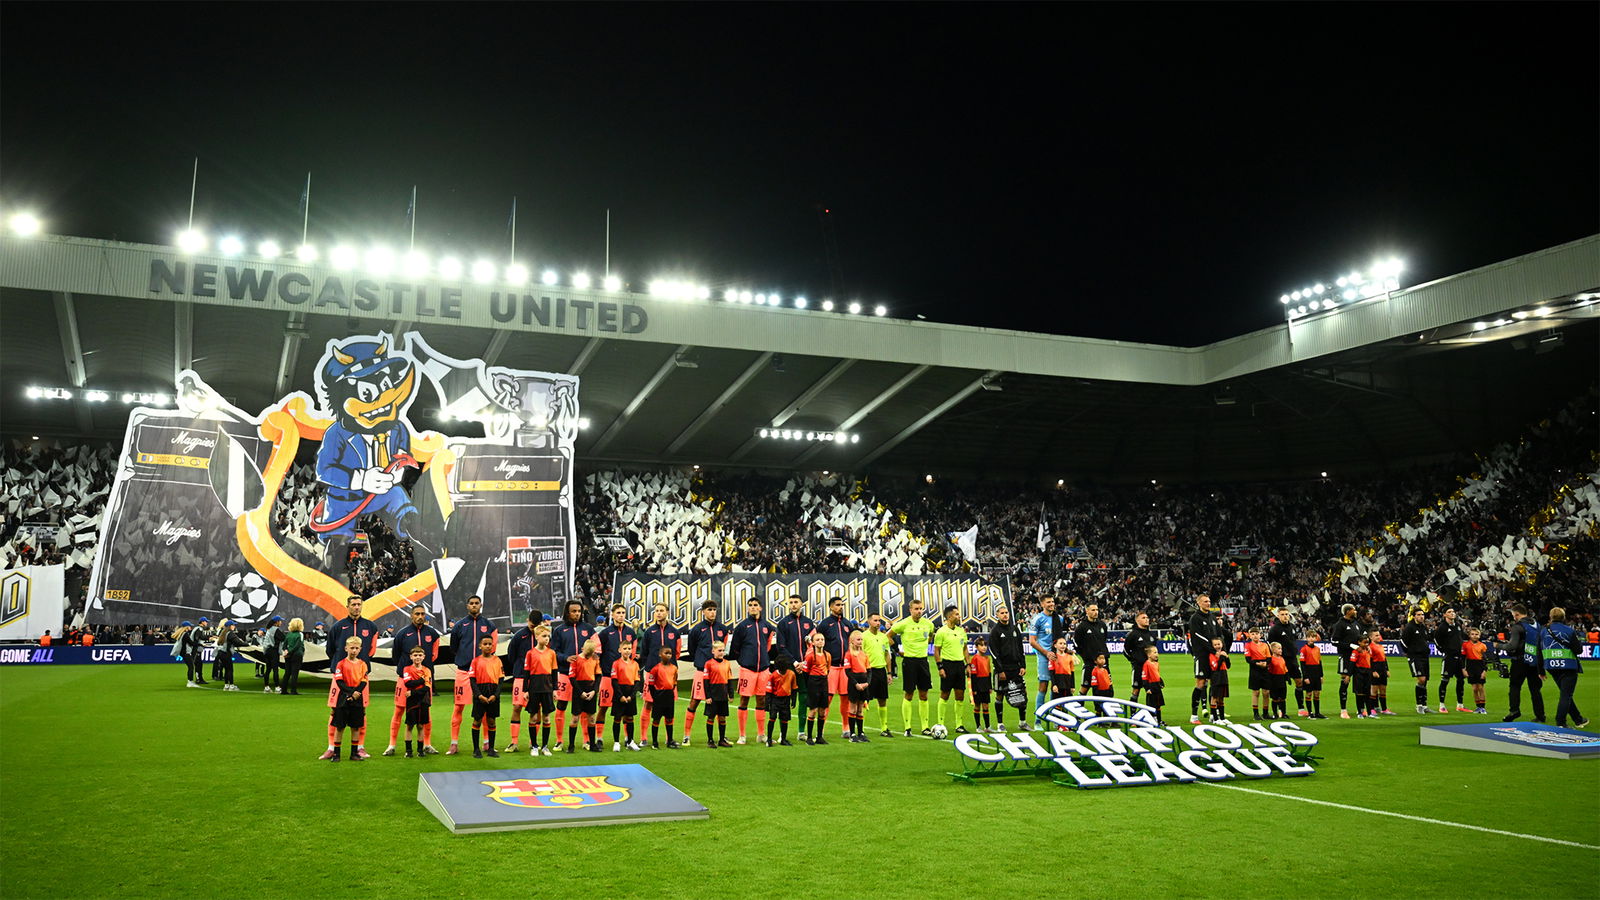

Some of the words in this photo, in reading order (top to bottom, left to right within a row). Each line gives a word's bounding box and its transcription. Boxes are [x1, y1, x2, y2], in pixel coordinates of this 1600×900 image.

[150, 259, 462, 319] NEWCASTLE
[490, 291, 649, 333] UNITED
[171, 431, 215, 454] Magpies
[494, 459, 530, 480] Magpies
[153, 520, 202, 546] Magpies
[107, 591, 129, 600] 1892
[622, 578, 712, 629] BACK
[721, 578, 755, 627] IN
[879, 578, 904, 622] &
[0, 649, 30, 662] COME
[31, 649, 54, 662] ALL
[92, 650, 131, 661] UEFA
[1163, 643, 1188, 651] UEFA
[1383, 644, 1399, 654] EFA
[455, 686, 463, 695] 14
[601, 690, 609, 698] 16
[1044, 701, 1160, 728] UEFA
[954, 721, 1319, 762] CHAMPIONS
[1053, 746, 1315, 787] LEAGUE
